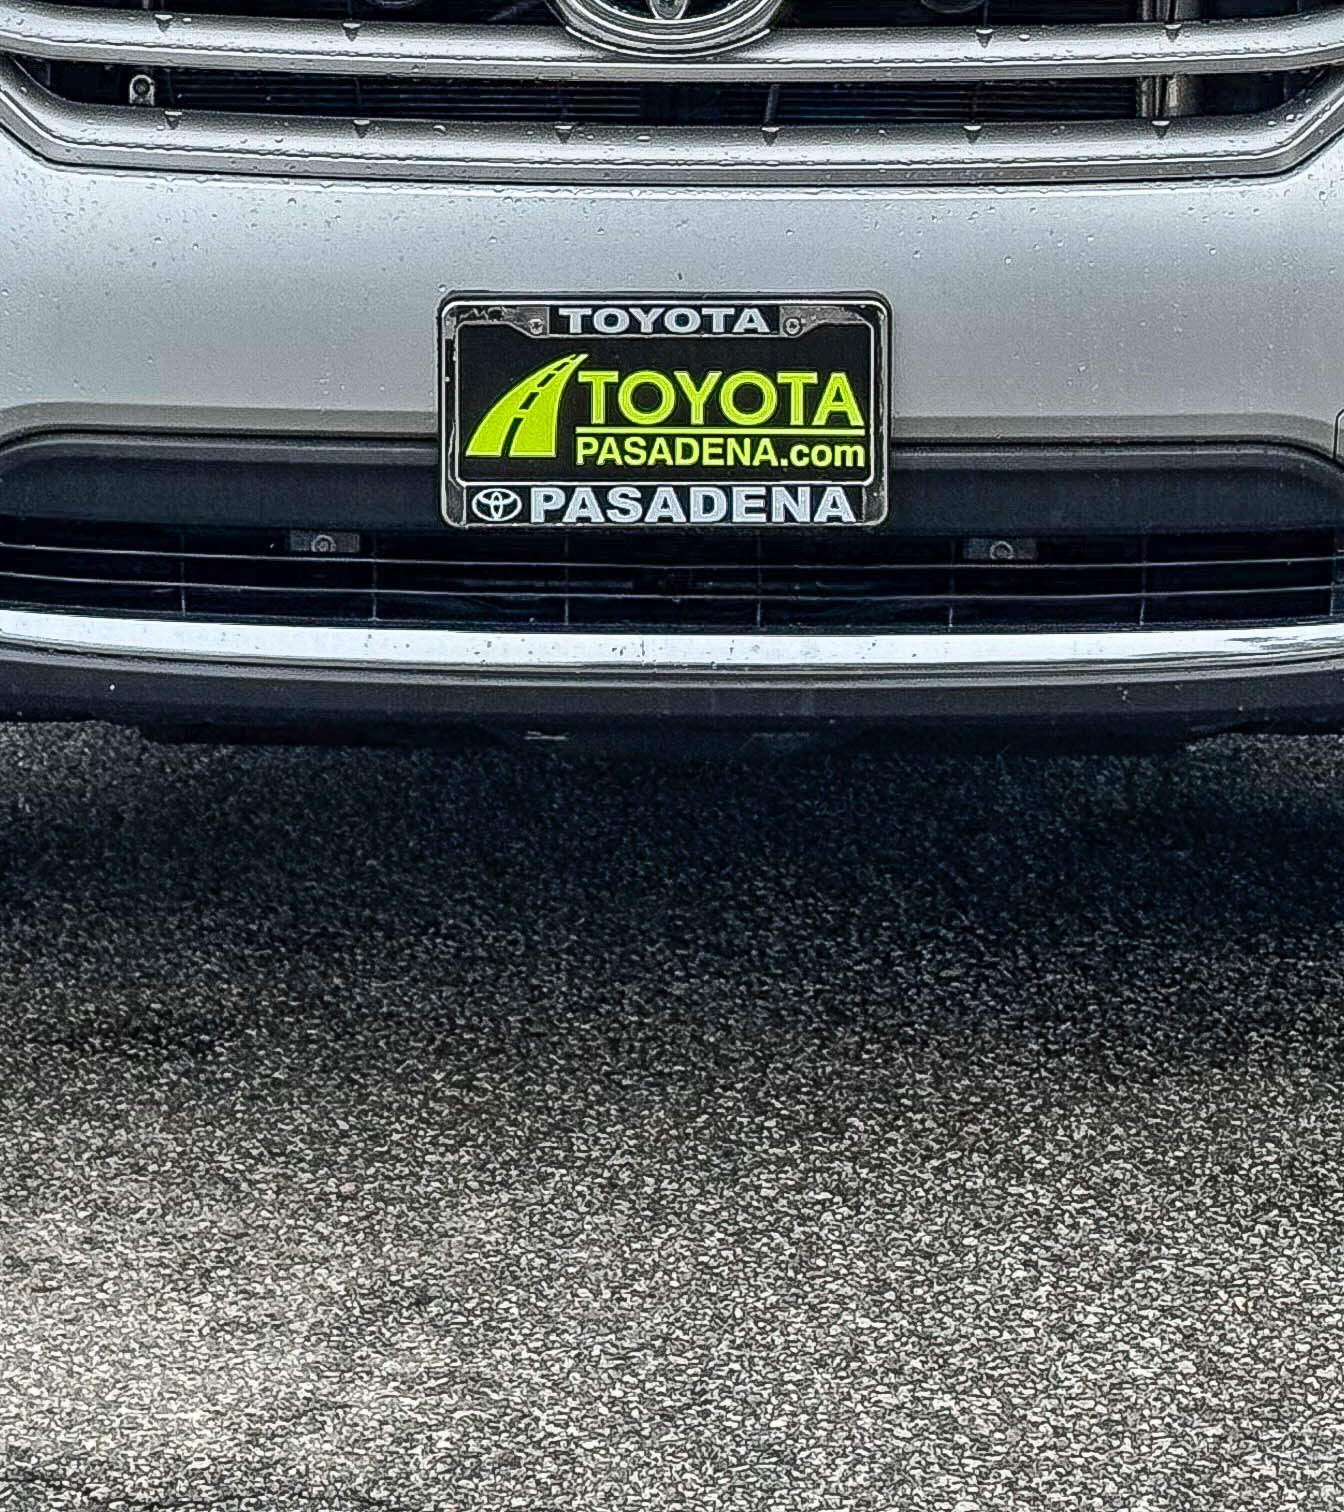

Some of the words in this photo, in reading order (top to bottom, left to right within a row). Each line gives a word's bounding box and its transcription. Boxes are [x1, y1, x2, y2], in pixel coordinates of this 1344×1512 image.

[558, 306, 770, 335] TOYOTA
[577, 370, 865, 427] TOYOTA
[575, 435, 866, 468] PASADENA.com
[529, 485, 858, 525] PASADENA
